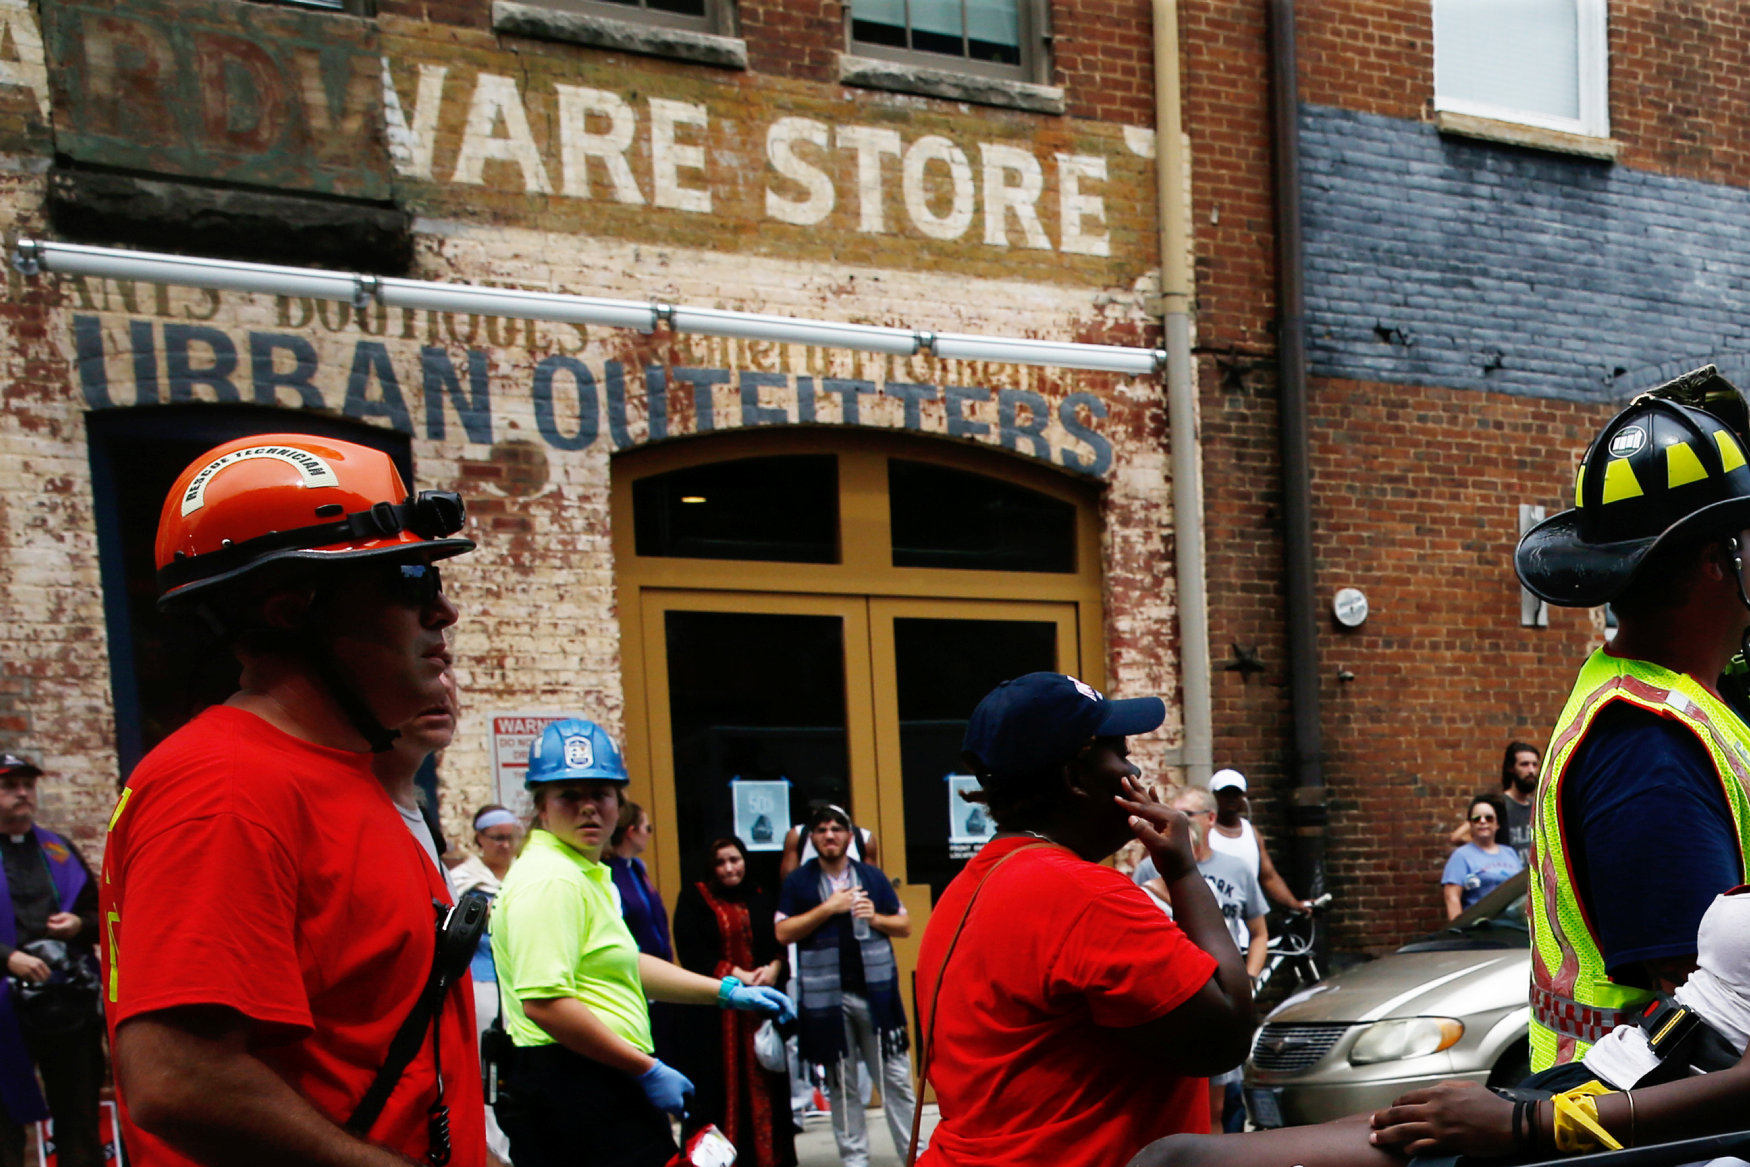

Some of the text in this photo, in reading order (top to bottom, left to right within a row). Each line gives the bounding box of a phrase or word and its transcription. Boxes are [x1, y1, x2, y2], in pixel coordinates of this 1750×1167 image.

[765, 116, 1112, 258] STORE
[73, 314, 494, 444] URBAN
[532, 354, 1113, 476] OUTFITTERS
[185, 447, 326, 502] RESCUE TECHNICIAN
[498, 718, 550, 734] WARN
